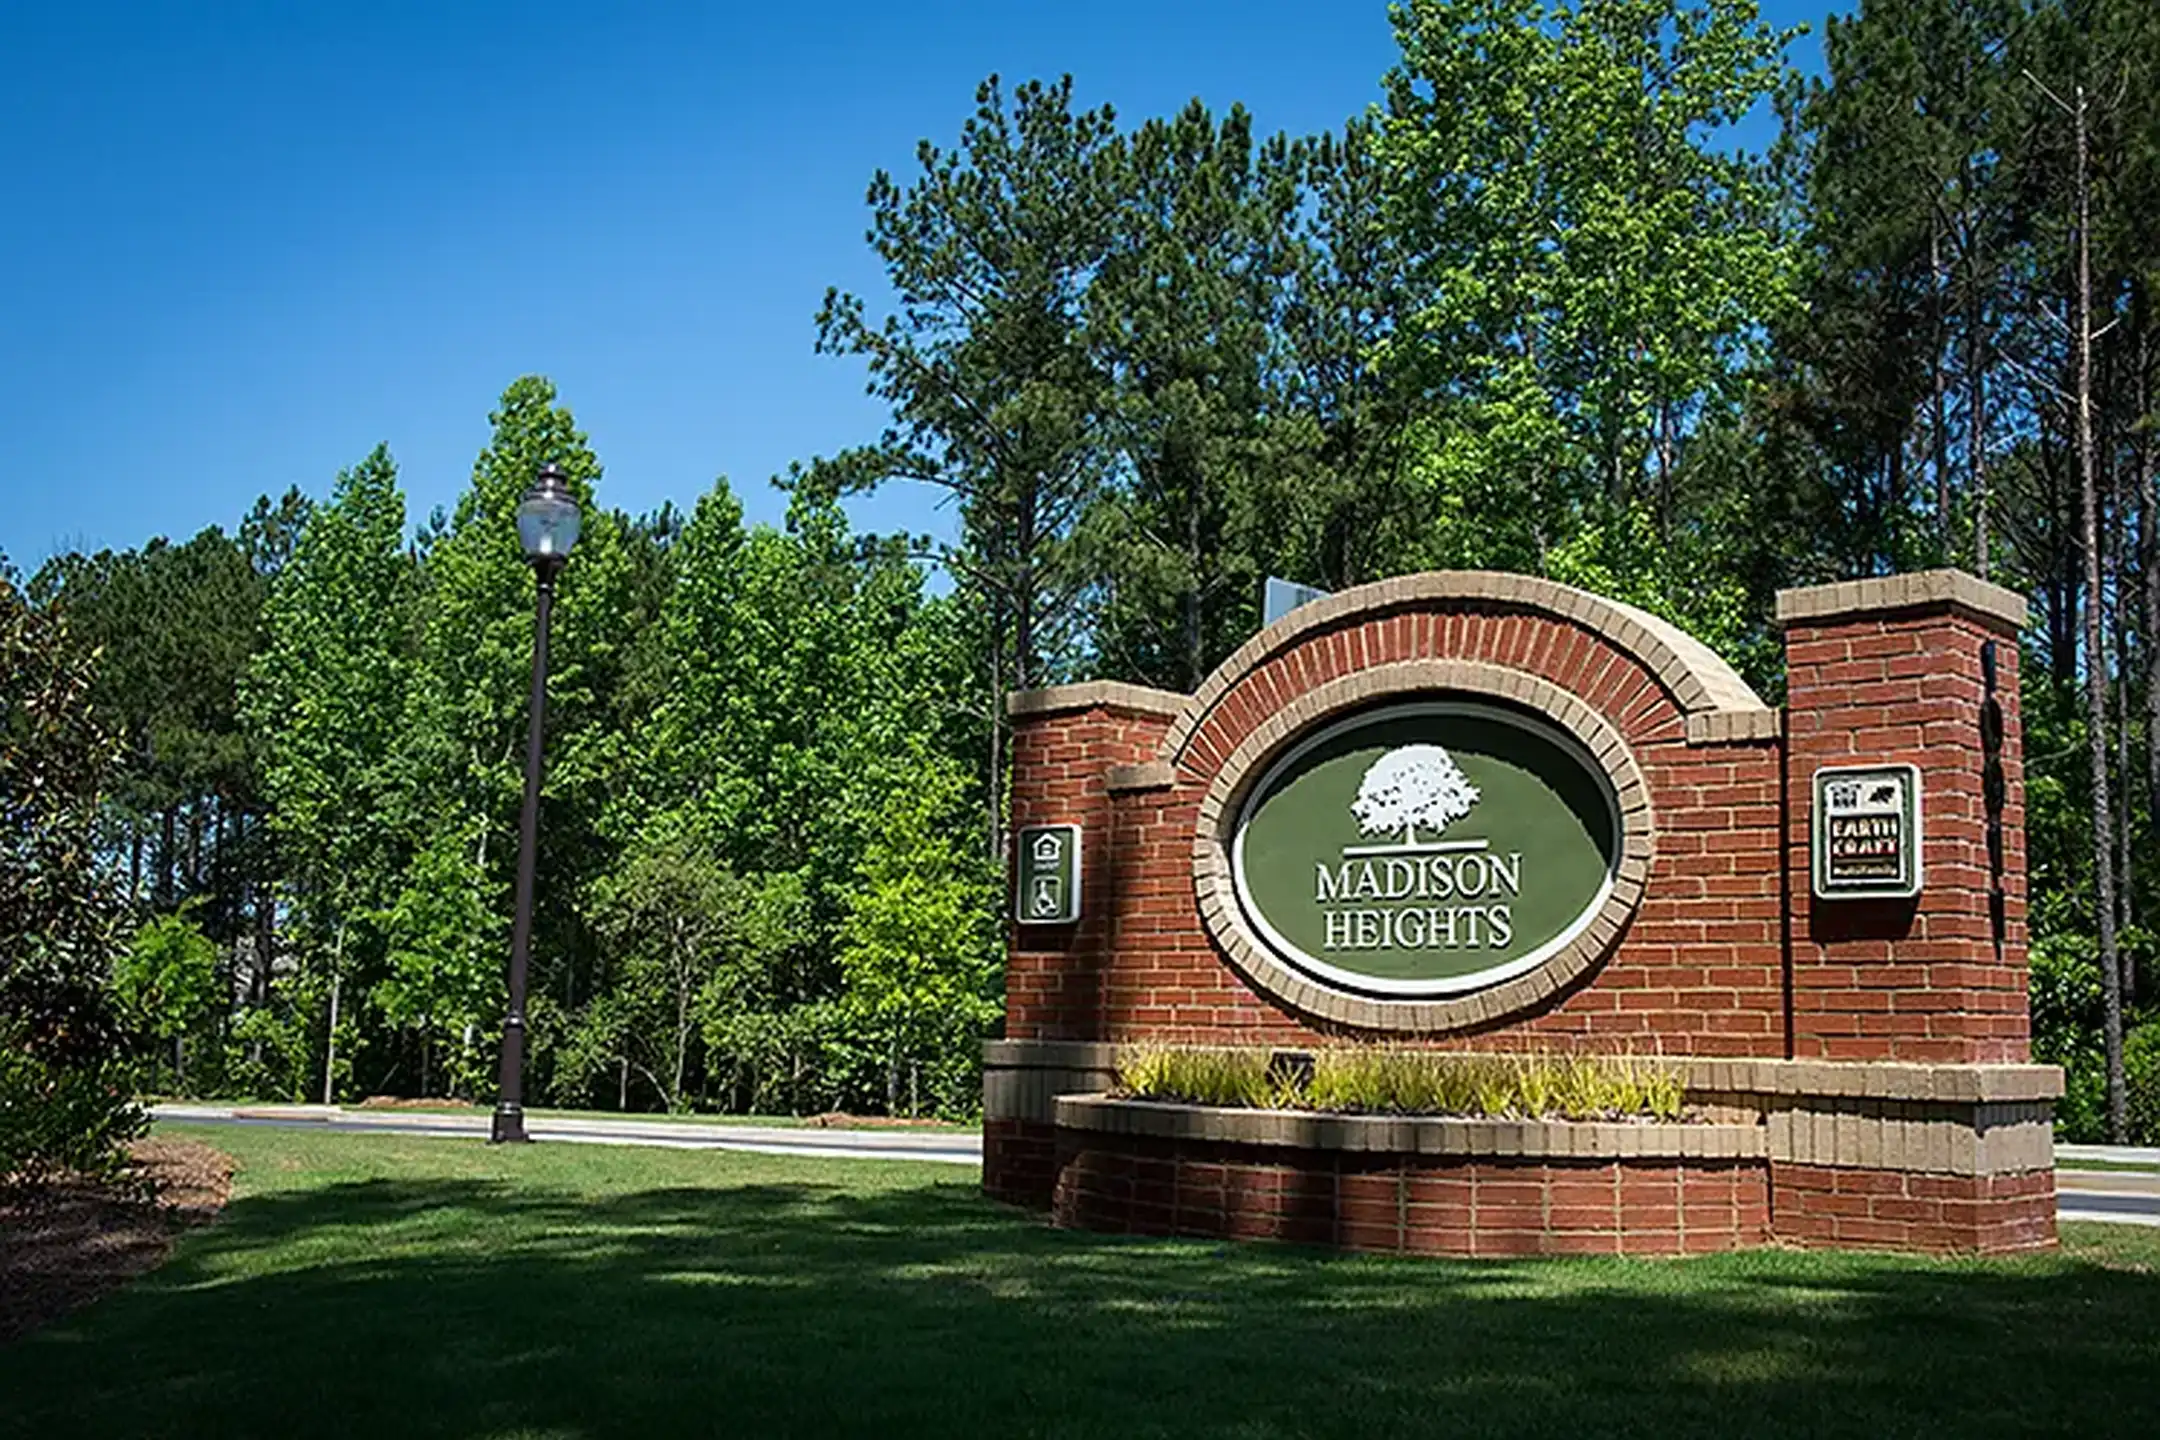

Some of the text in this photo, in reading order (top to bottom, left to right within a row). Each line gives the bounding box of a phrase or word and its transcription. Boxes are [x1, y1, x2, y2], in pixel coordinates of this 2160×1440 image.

[1832, 818, 1898, 837] EARTH
[1316, 853, 1522, 900] MADISON
[1323, 905, 1513, 948] HEIGHTS
